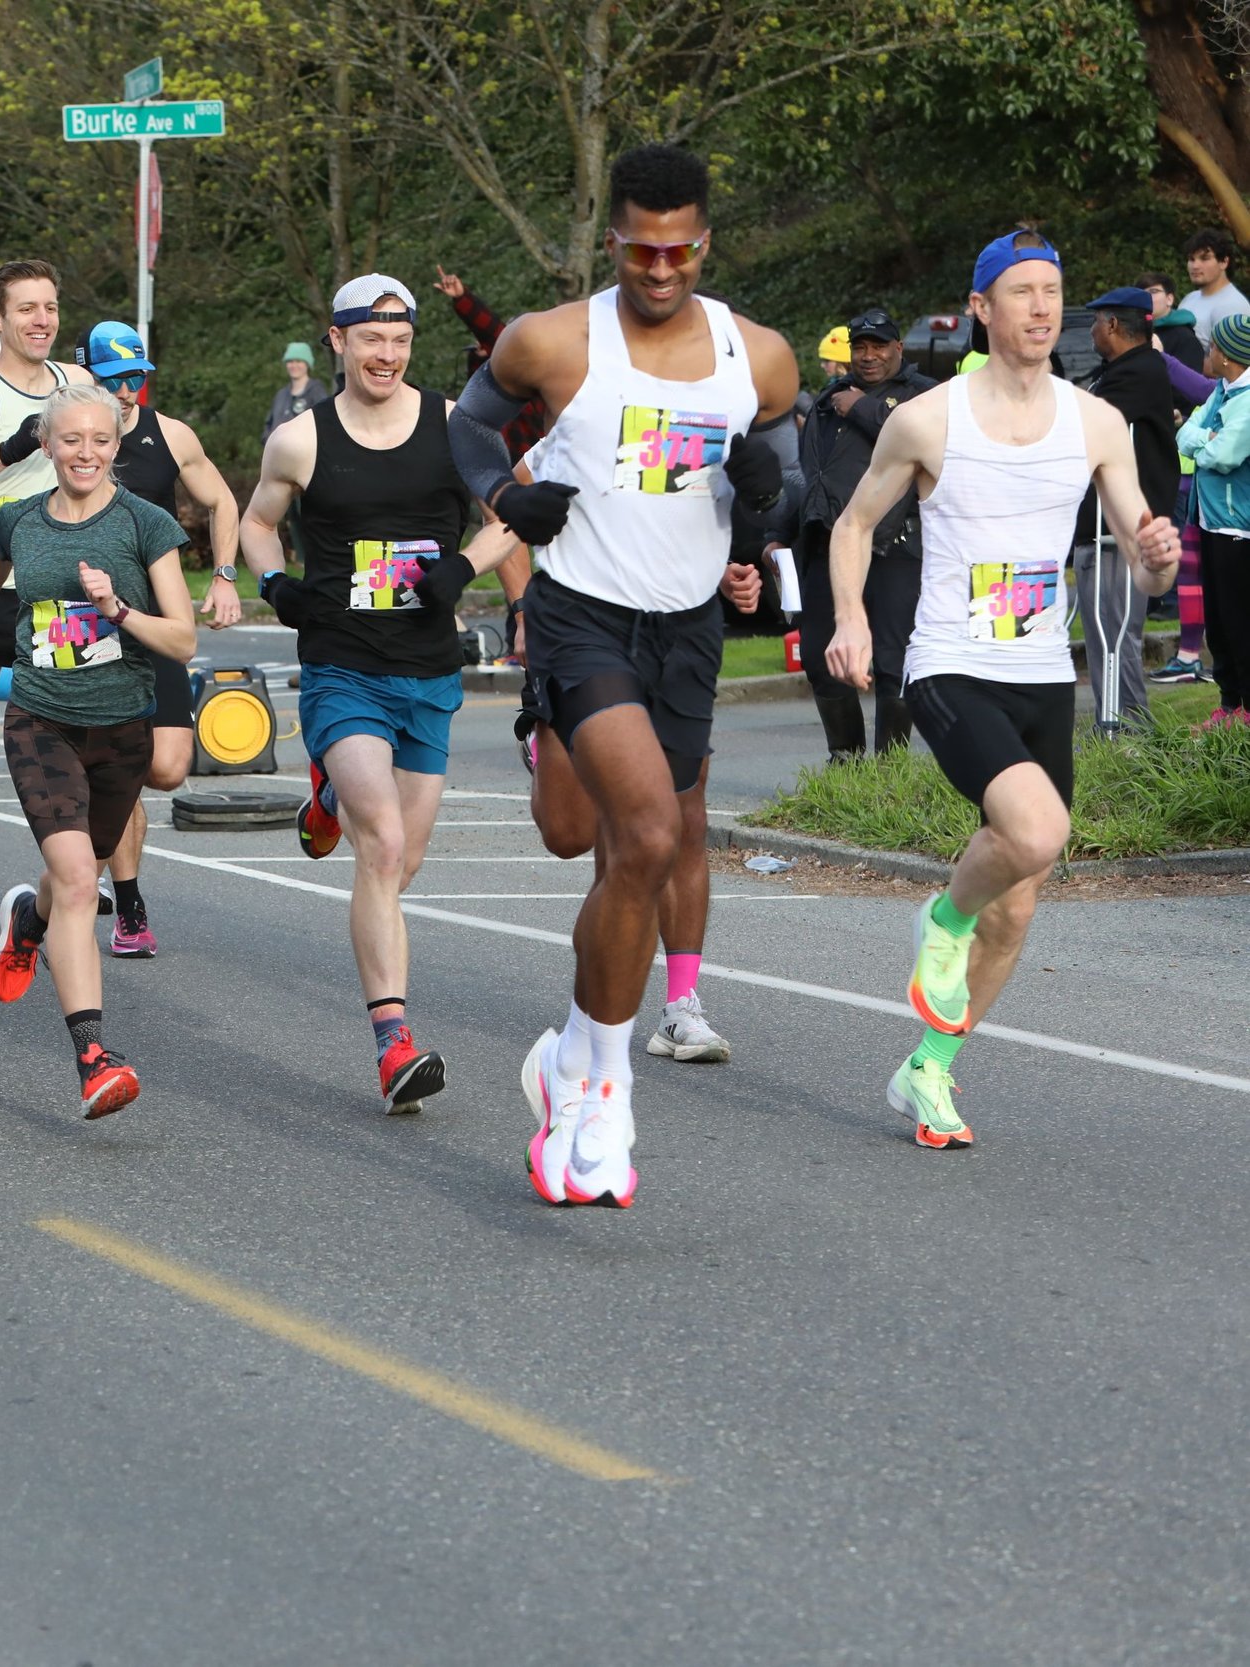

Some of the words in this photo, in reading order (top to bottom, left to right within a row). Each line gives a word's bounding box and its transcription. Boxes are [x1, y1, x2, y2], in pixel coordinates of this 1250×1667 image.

[72, 108, 137, 134] Burke
[146, 114, 173, 131] Ave
[184, 113, 195, 130] N
[639, 429, 705, 471] 374
[988, 580, 1046, 618] 381
[48, 611, 98, 648] 447
